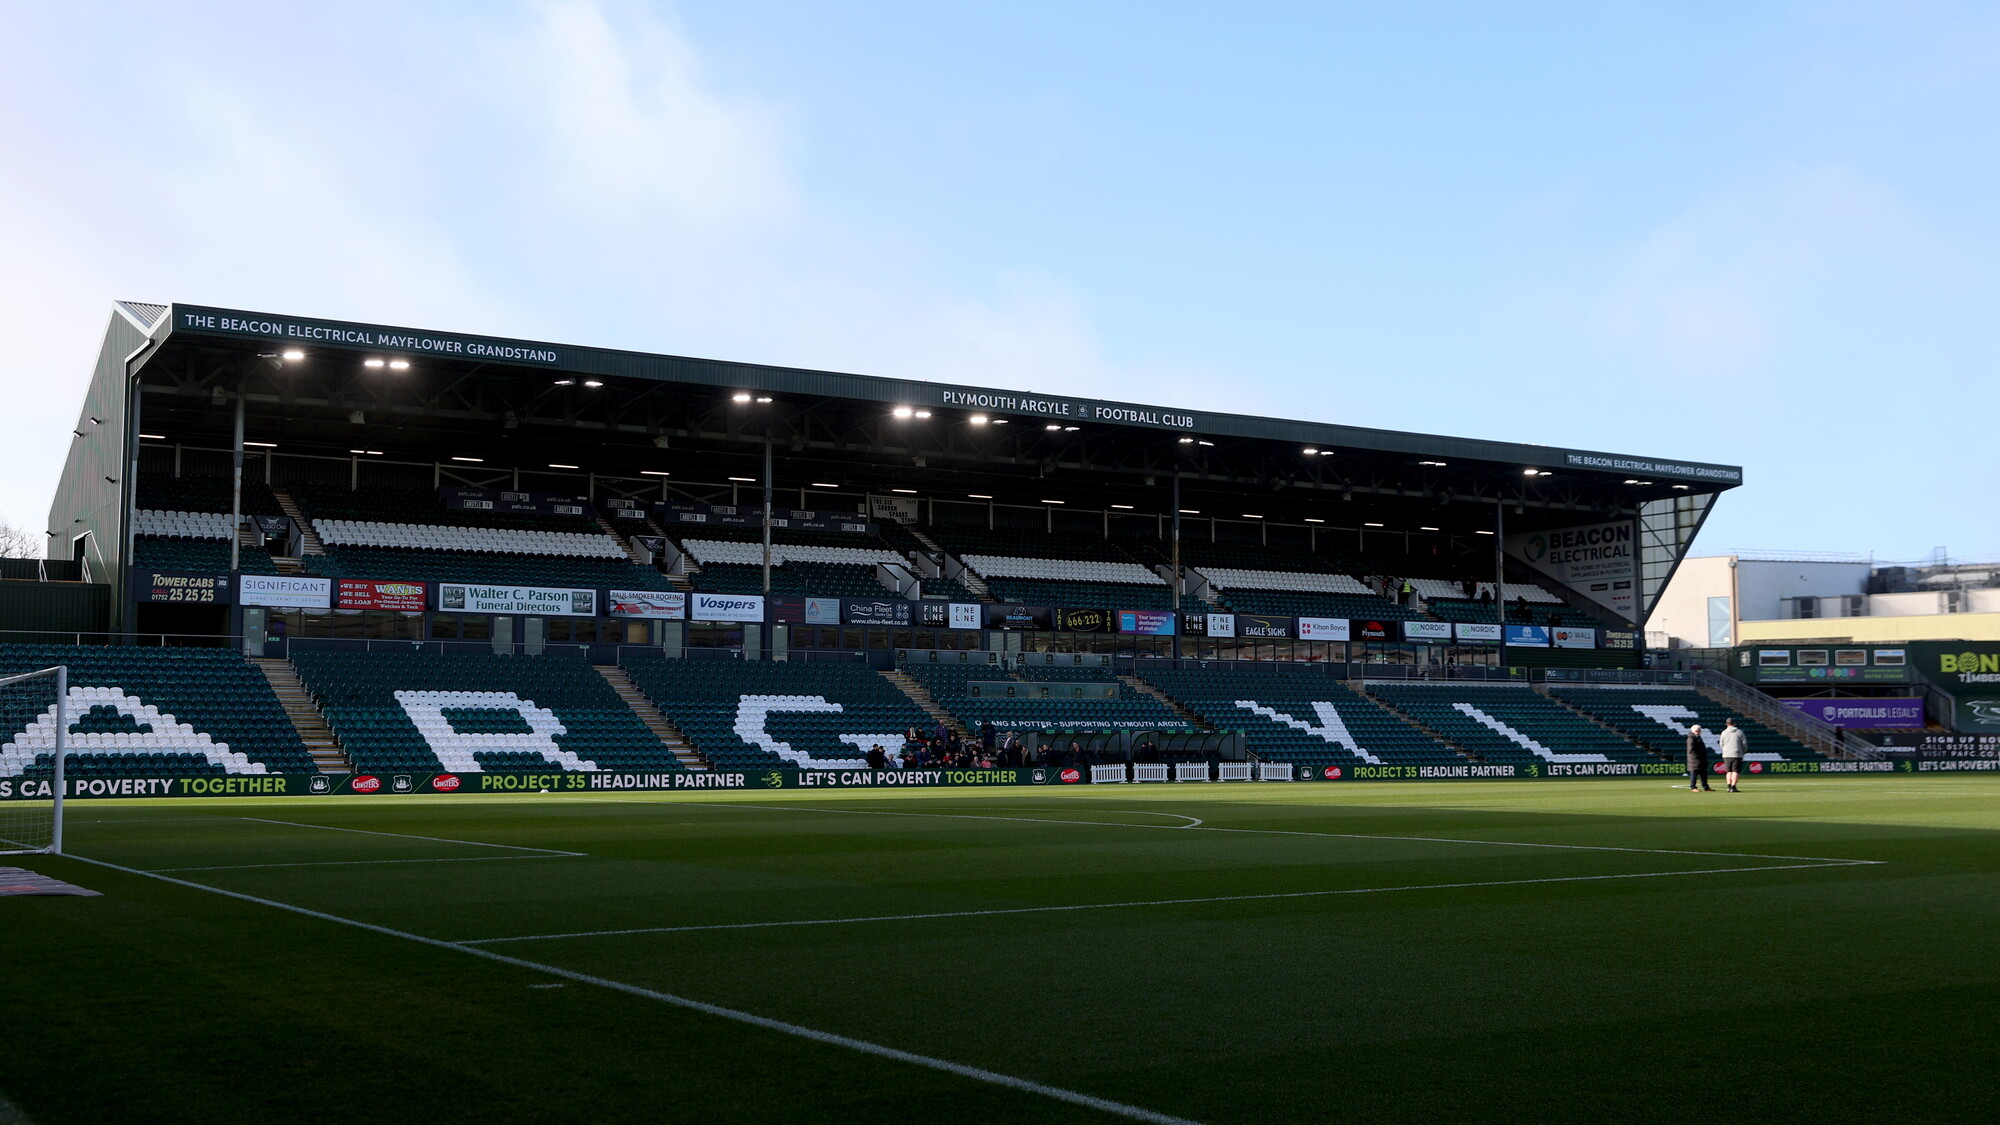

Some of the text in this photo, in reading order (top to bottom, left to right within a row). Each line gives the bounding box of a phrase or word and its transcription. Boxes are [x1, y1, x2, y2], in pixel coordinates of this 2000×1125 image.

[185, 314, 557, 362] THE BEACON ELECTRICAL MAYFLOWER GRANDSTAND
[943, 391, 1193, 428] PLYMOUTH ARGYLE FOOTBALL CLUB
[1568, 455, 1739, 480] THE BEACON ELECTRICAL MAYFLOWER GRANDSTAND
[1549, 525, 1630, 549] BEACON
[1550, 544, 1630, 564] ELECTRICAL
[152, 574, 187, 587] TOWER
[189, 578, 214, 588] CABS
[245, 580, 327, 592] SIGNIFICANT
[169, 588, 183, 601] 25
[185, 588, 199, 601] 25
[200, 589, 214, 602] 25
[374, 584, 424, 595] WANTS
[468, 588, 569, 602] Walter C. Parson
[476, 601, 561, 612] Funeral Directors
[700, 597, 756, 611] Vospers
[850, 604, 892, 612] China Fleet
[851, 618, 909, 626] www.china-fleet.co.uk
[1067, 614, 1100, 627] 666-222
[1245, 627, 1286, 637] EAGLE SIGNS
[1330, 624, 1346, 632] Boyce
[1420, 624, 1445, 632] NORDIC
[1470, 625, 1495, 633] NORDIC
[1837, 707, 1916, 719] PORTCULLIS LEGALS
[1018, 720, 1052, 728] POTTER
[1060, 720, 1111, 728] SUPPORTING
[1925, 736, 1954, 744] SIGN
[1920, 743, 1942, 751] CALL
[1922, 750, 1947, 758] VISIT
[1354, 765, 1515, 778] PROJECT 35 HEADLINE PARTNER
[1574, 764, 1595, 775] CAN
[1596, 764, 1638, 775] POVERTY
[1640, 763, 1686, 775] TOGETHER
[1771, 762, 1807, 773] PROJECT
[1807, 762, 1818, 772] 35
[1819, 762, 1858, 772] HEADLINE
[1859, 761, 1894, 772] PARTNER
[1940, 760, 1957, 771] CAN
[481, 773, 745, 790] PROJECT 35 HEADLINE PARTNER
[840, 771, 872, 786] CAN
[876, 771, 942, 785] POVERTY
[945, 770, 1017, 784] TOGETHER
[75, 778, 174, 796] POVERTY
[180, 777, 287, 795] TOGETHER
